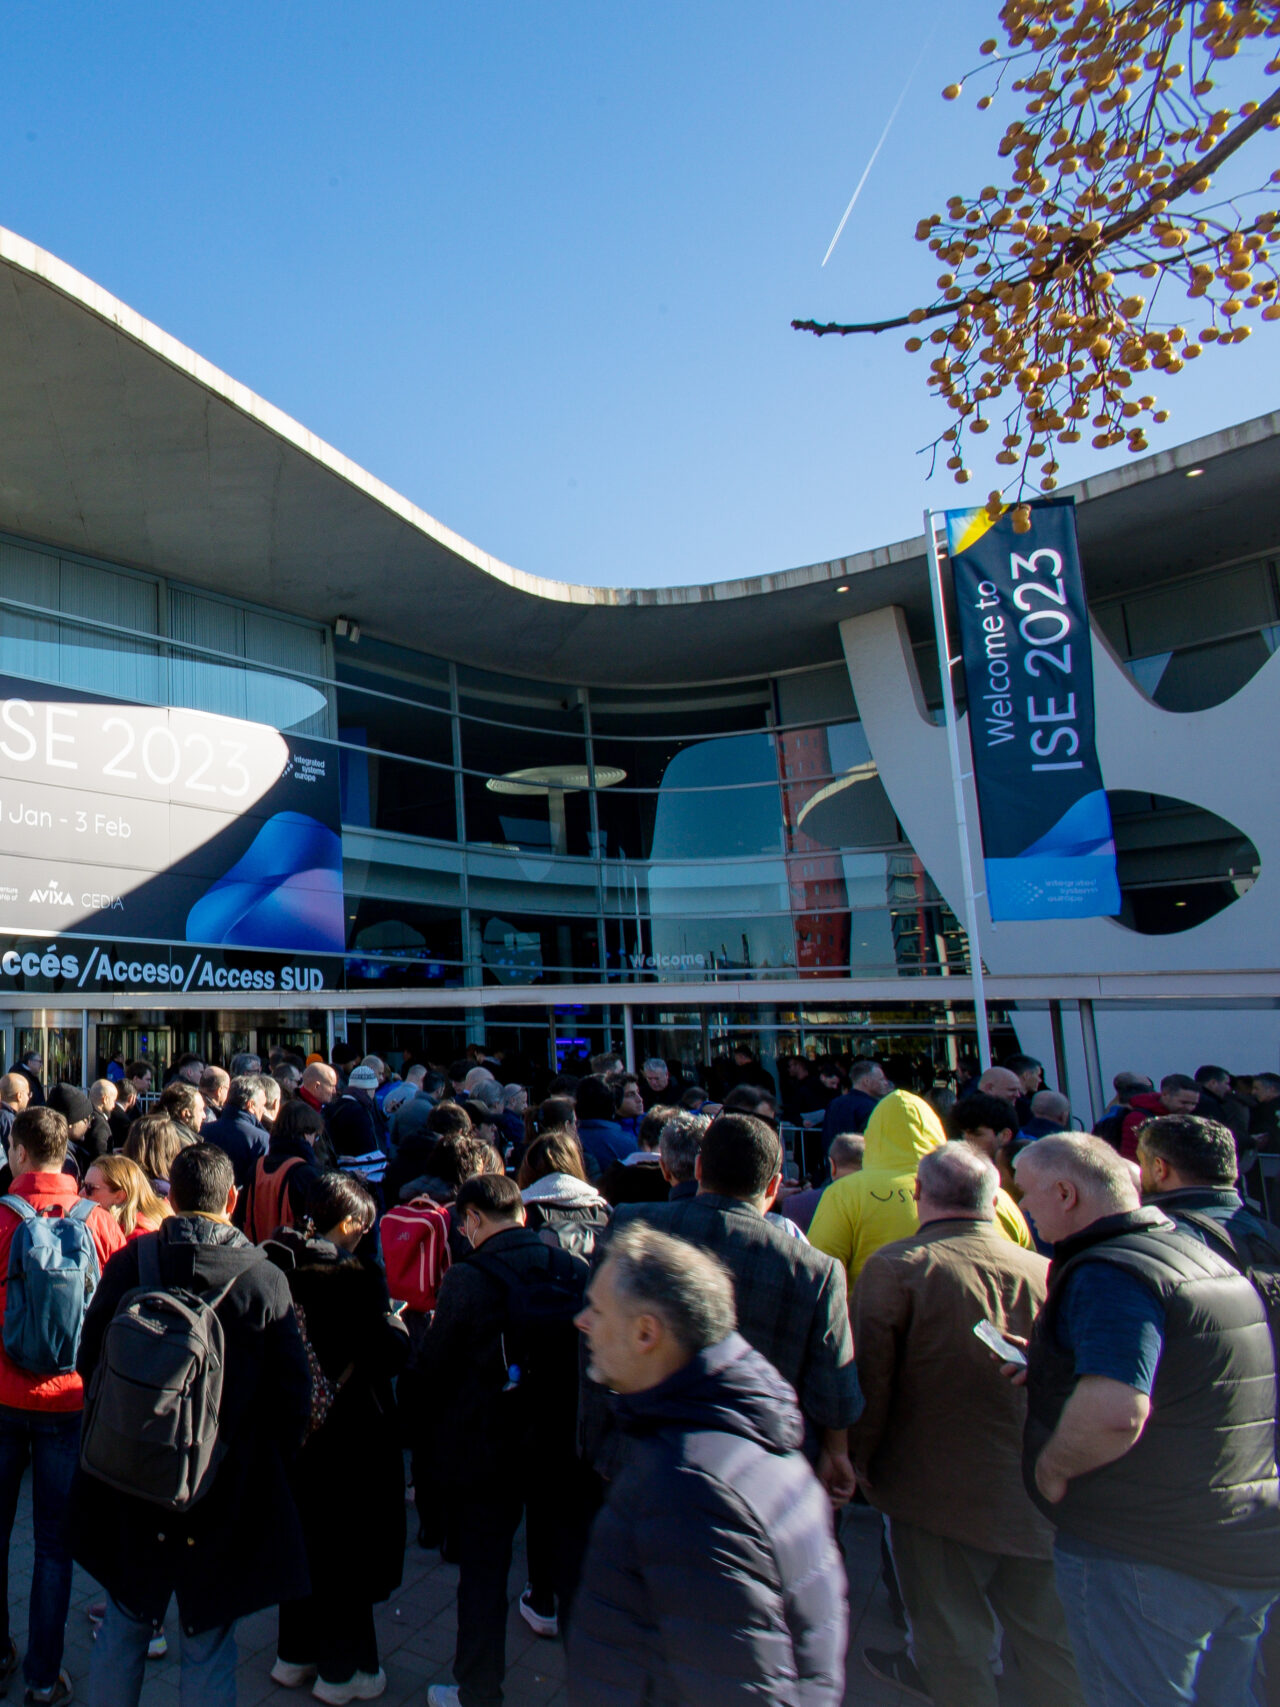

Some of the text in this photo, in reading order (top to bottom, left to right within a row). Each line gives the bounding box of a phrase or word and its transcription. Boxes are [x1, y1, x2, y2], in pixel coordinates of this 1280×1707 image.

[974, 580, 1015, 747] Welcome to
[1009, 547, 1084, 772] ISE 2023
[101, 717, 252, 797] 2023
[8, 803, 52, 828] Jan
[74, 810, 88, 833] 3
[94, 813, 132, 839] Feb
[28, 889, 74, 906] AVIXA
[81, 892, 125, 911] CEDIA
[628, 952, 706, 969] Welcome
[280, 966, 324, 991] SUD
